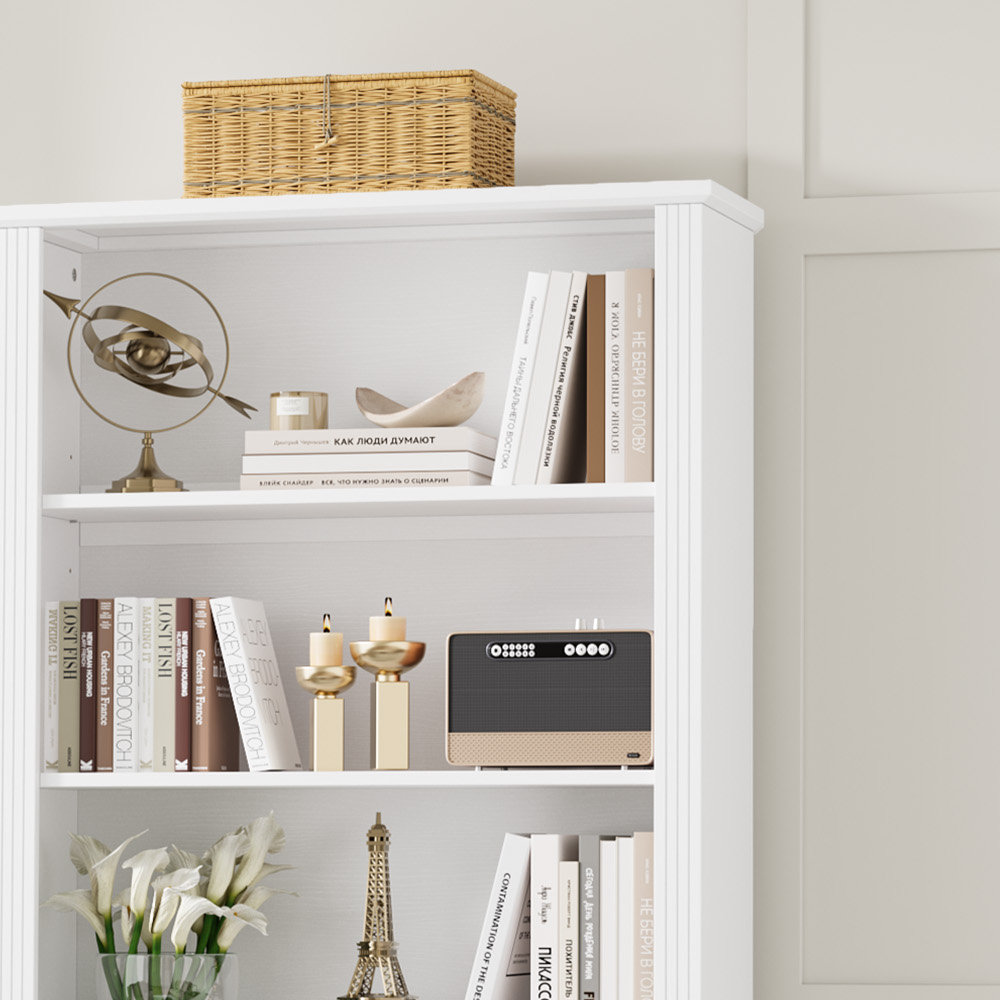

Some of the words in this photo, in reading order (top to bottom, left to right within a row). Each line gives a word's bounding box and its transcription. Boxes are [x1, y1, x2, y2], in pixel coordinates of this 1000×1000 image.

[632, 331, 645, 348] НЕ
[557, 346, 571, 383] Религия
[632, 352, 646, 385] БЕРИ
[506, 386, 522, 429] ДАЛЬНЕГО
[551, 385, 563, 417] черной
[632, 389, 646, 398] В
[357, 437, 388, 446] ЛЮДИ
[390, 436, 436, 445] ДУМАЮТ
[543, 419, 558, 467] водолазки
[632, 402, 646, 454] ГОЛОВУ
[500, 431, 514, 469] ВОСТОКА
[63, 606, 77, 644] LOST
[117, 603, 132, 661] ALEXEY
[142, 606, 152, 649] MAKING
[158, 603, 172, 641] LOST
[215, 603, 242, 659] ALEXEY
[63, 648, 77, 679] FISH
[100, 651, 111, 684] Gardens
[142, 652, 151, 663] IT
[158, 645, 172, 678] FISH
[195, 649, 206, 684] Gardens
[101, 686, 110, 695] in
[196, 686, 205, 694] in
[100, 697, 110, 726] France
[116, 665, 133, 761] BRODOVITCH
[195, 697, 205, 725] France
[228, 663, 265, 760] BRODOVITCH
[486, 873, 511, 950] CONTAMINATION
[583, 900, 594, 920] ДЕНЬ
[640, 898, 653, 915] НЕ
[640, 919, 653, 955] БЕРИ
[478, 966, 488, 982] THE
[482, 952, 492, 964] OF
[565, 939, 573, 998] ПОХИТИТЕЛЬ
[640, 959, 653, 967] В
